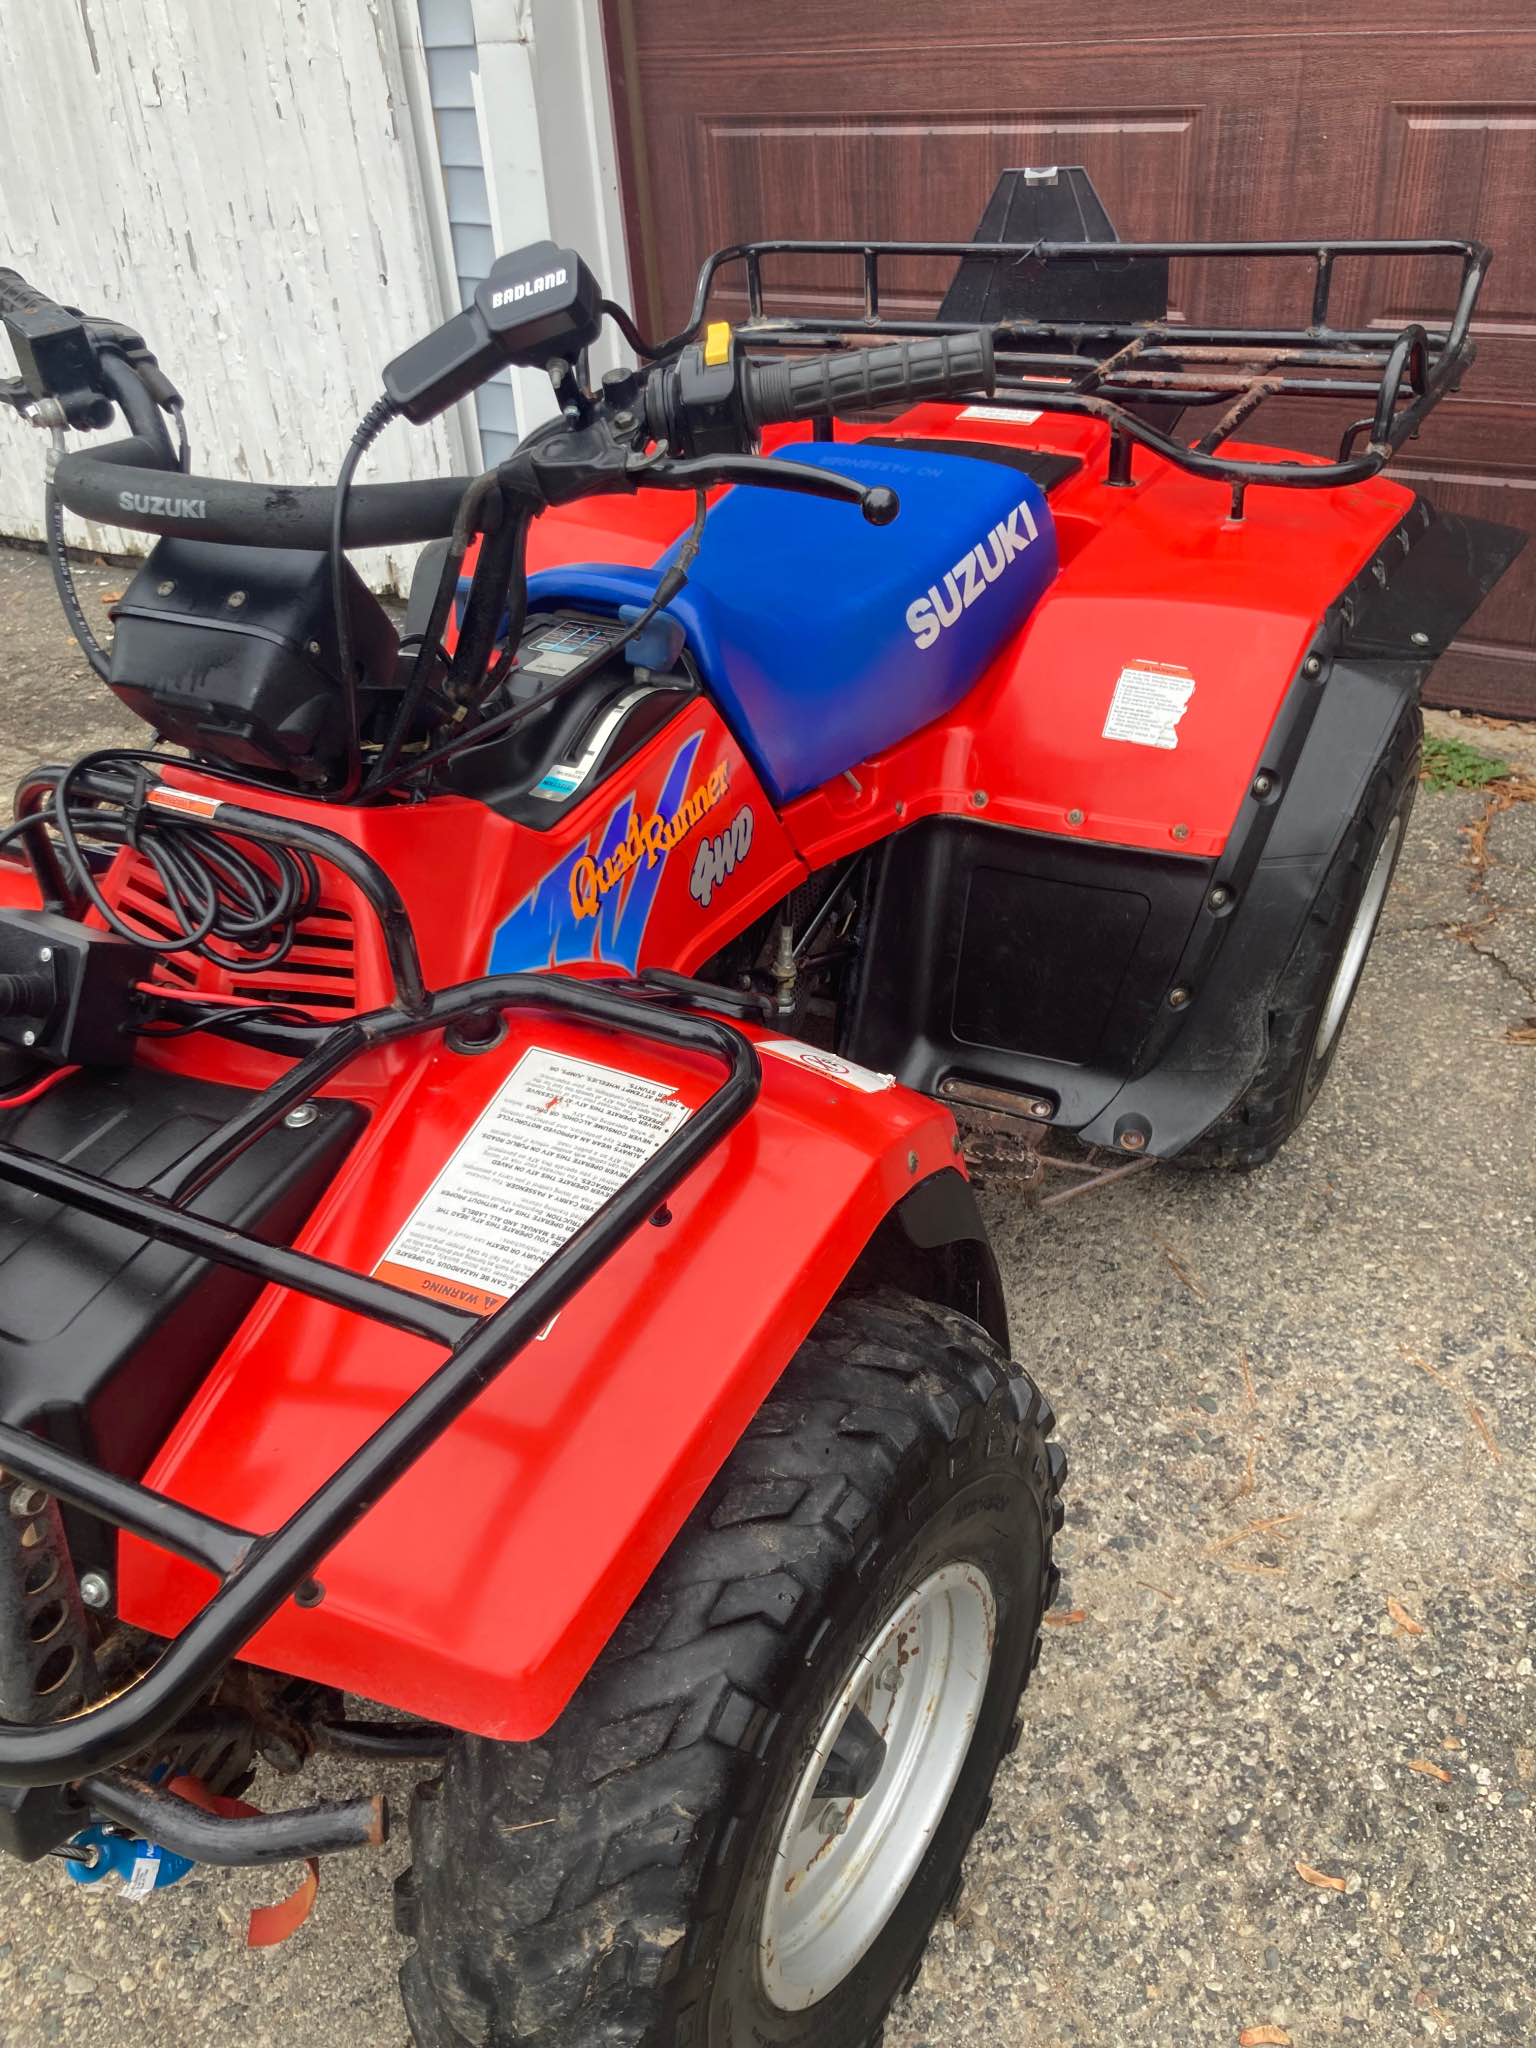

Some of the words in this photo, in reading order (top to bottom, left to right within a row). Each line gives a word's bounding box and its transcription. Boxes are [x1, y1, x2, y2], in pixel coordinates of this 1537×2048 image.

[492, 268, 567, 309] BADLAND
[119, 491, 206, 518] SUZUKI
[906, 500, 1038, 650] SUZUKI
[569, 760, 729, 919] QuadRunner
[689, 804, 755, 908] 4WD
[420, 1279, 479, 1303] WARNING
